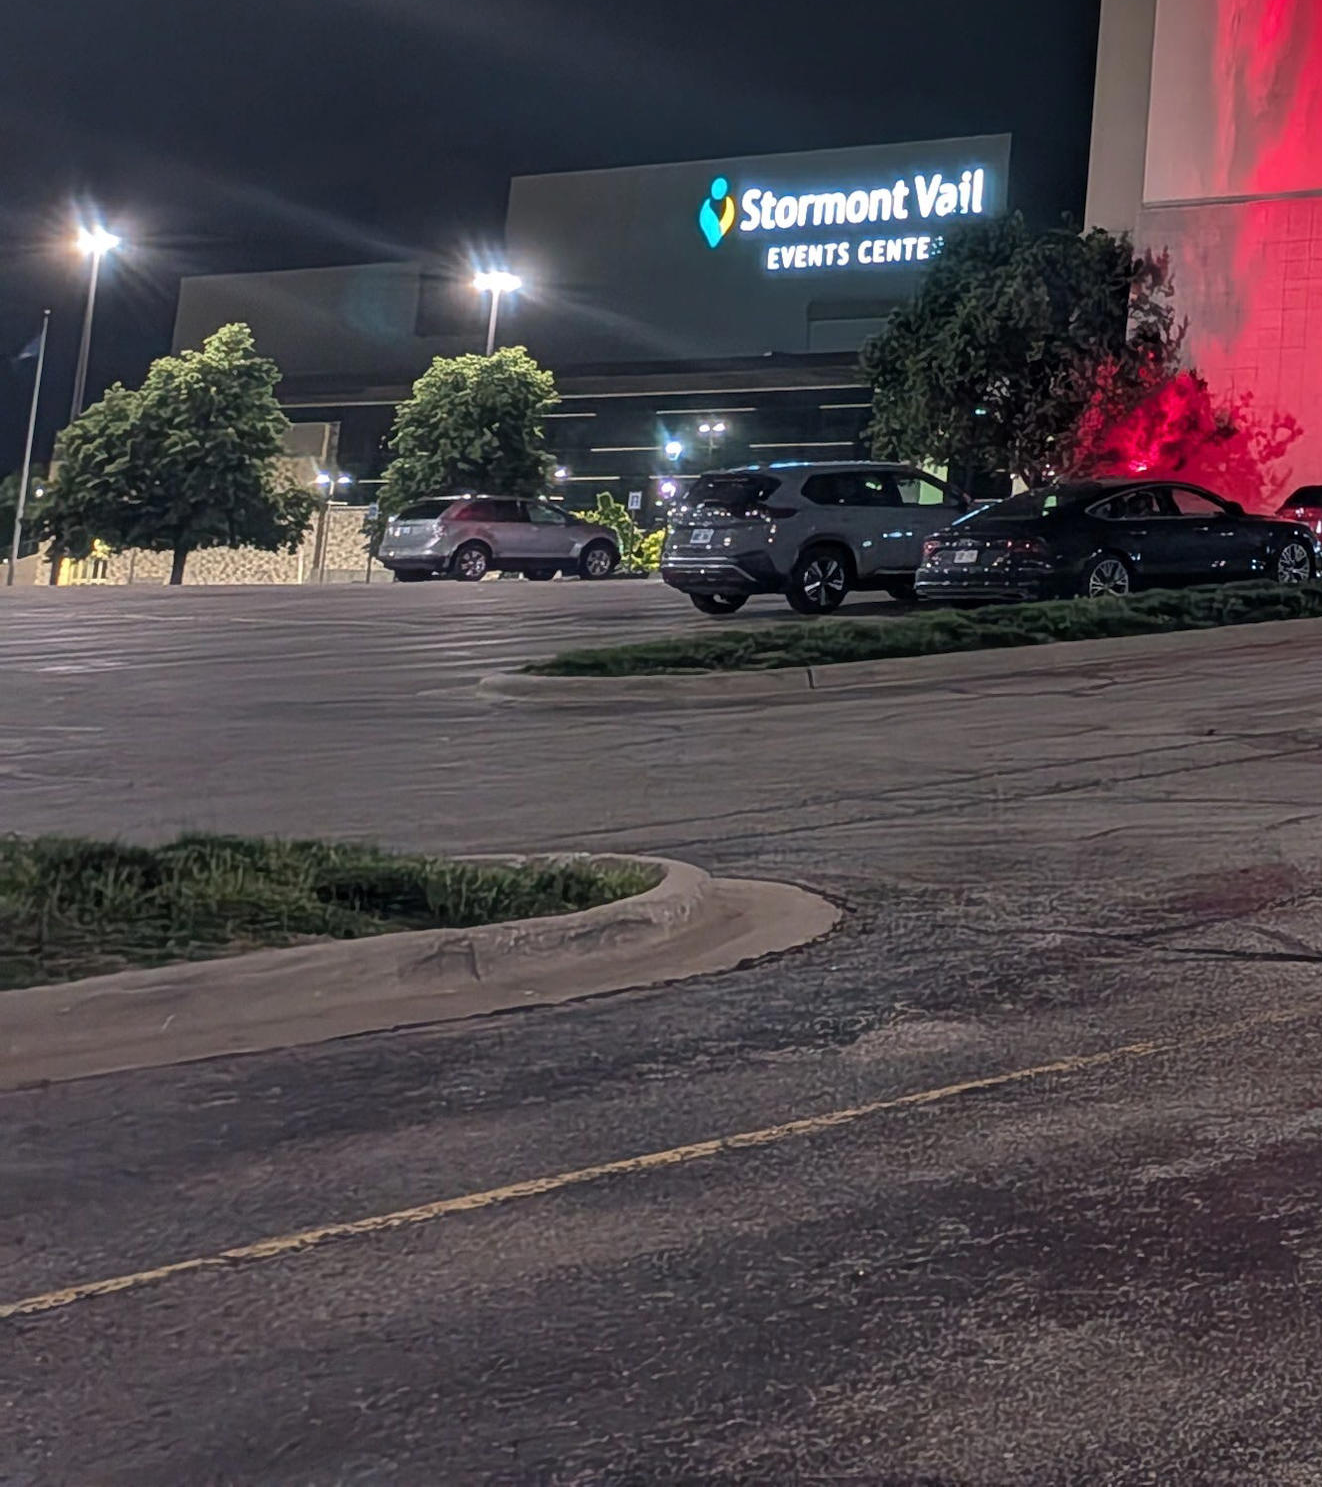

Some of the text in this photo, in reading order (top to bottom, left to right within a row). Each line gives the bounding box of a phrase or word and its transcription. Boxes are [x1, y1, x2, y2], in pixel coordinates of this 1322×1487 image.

[739, 168, 985, 232] Stormont Vail
[767, 242, 850, 271] EVENTS
